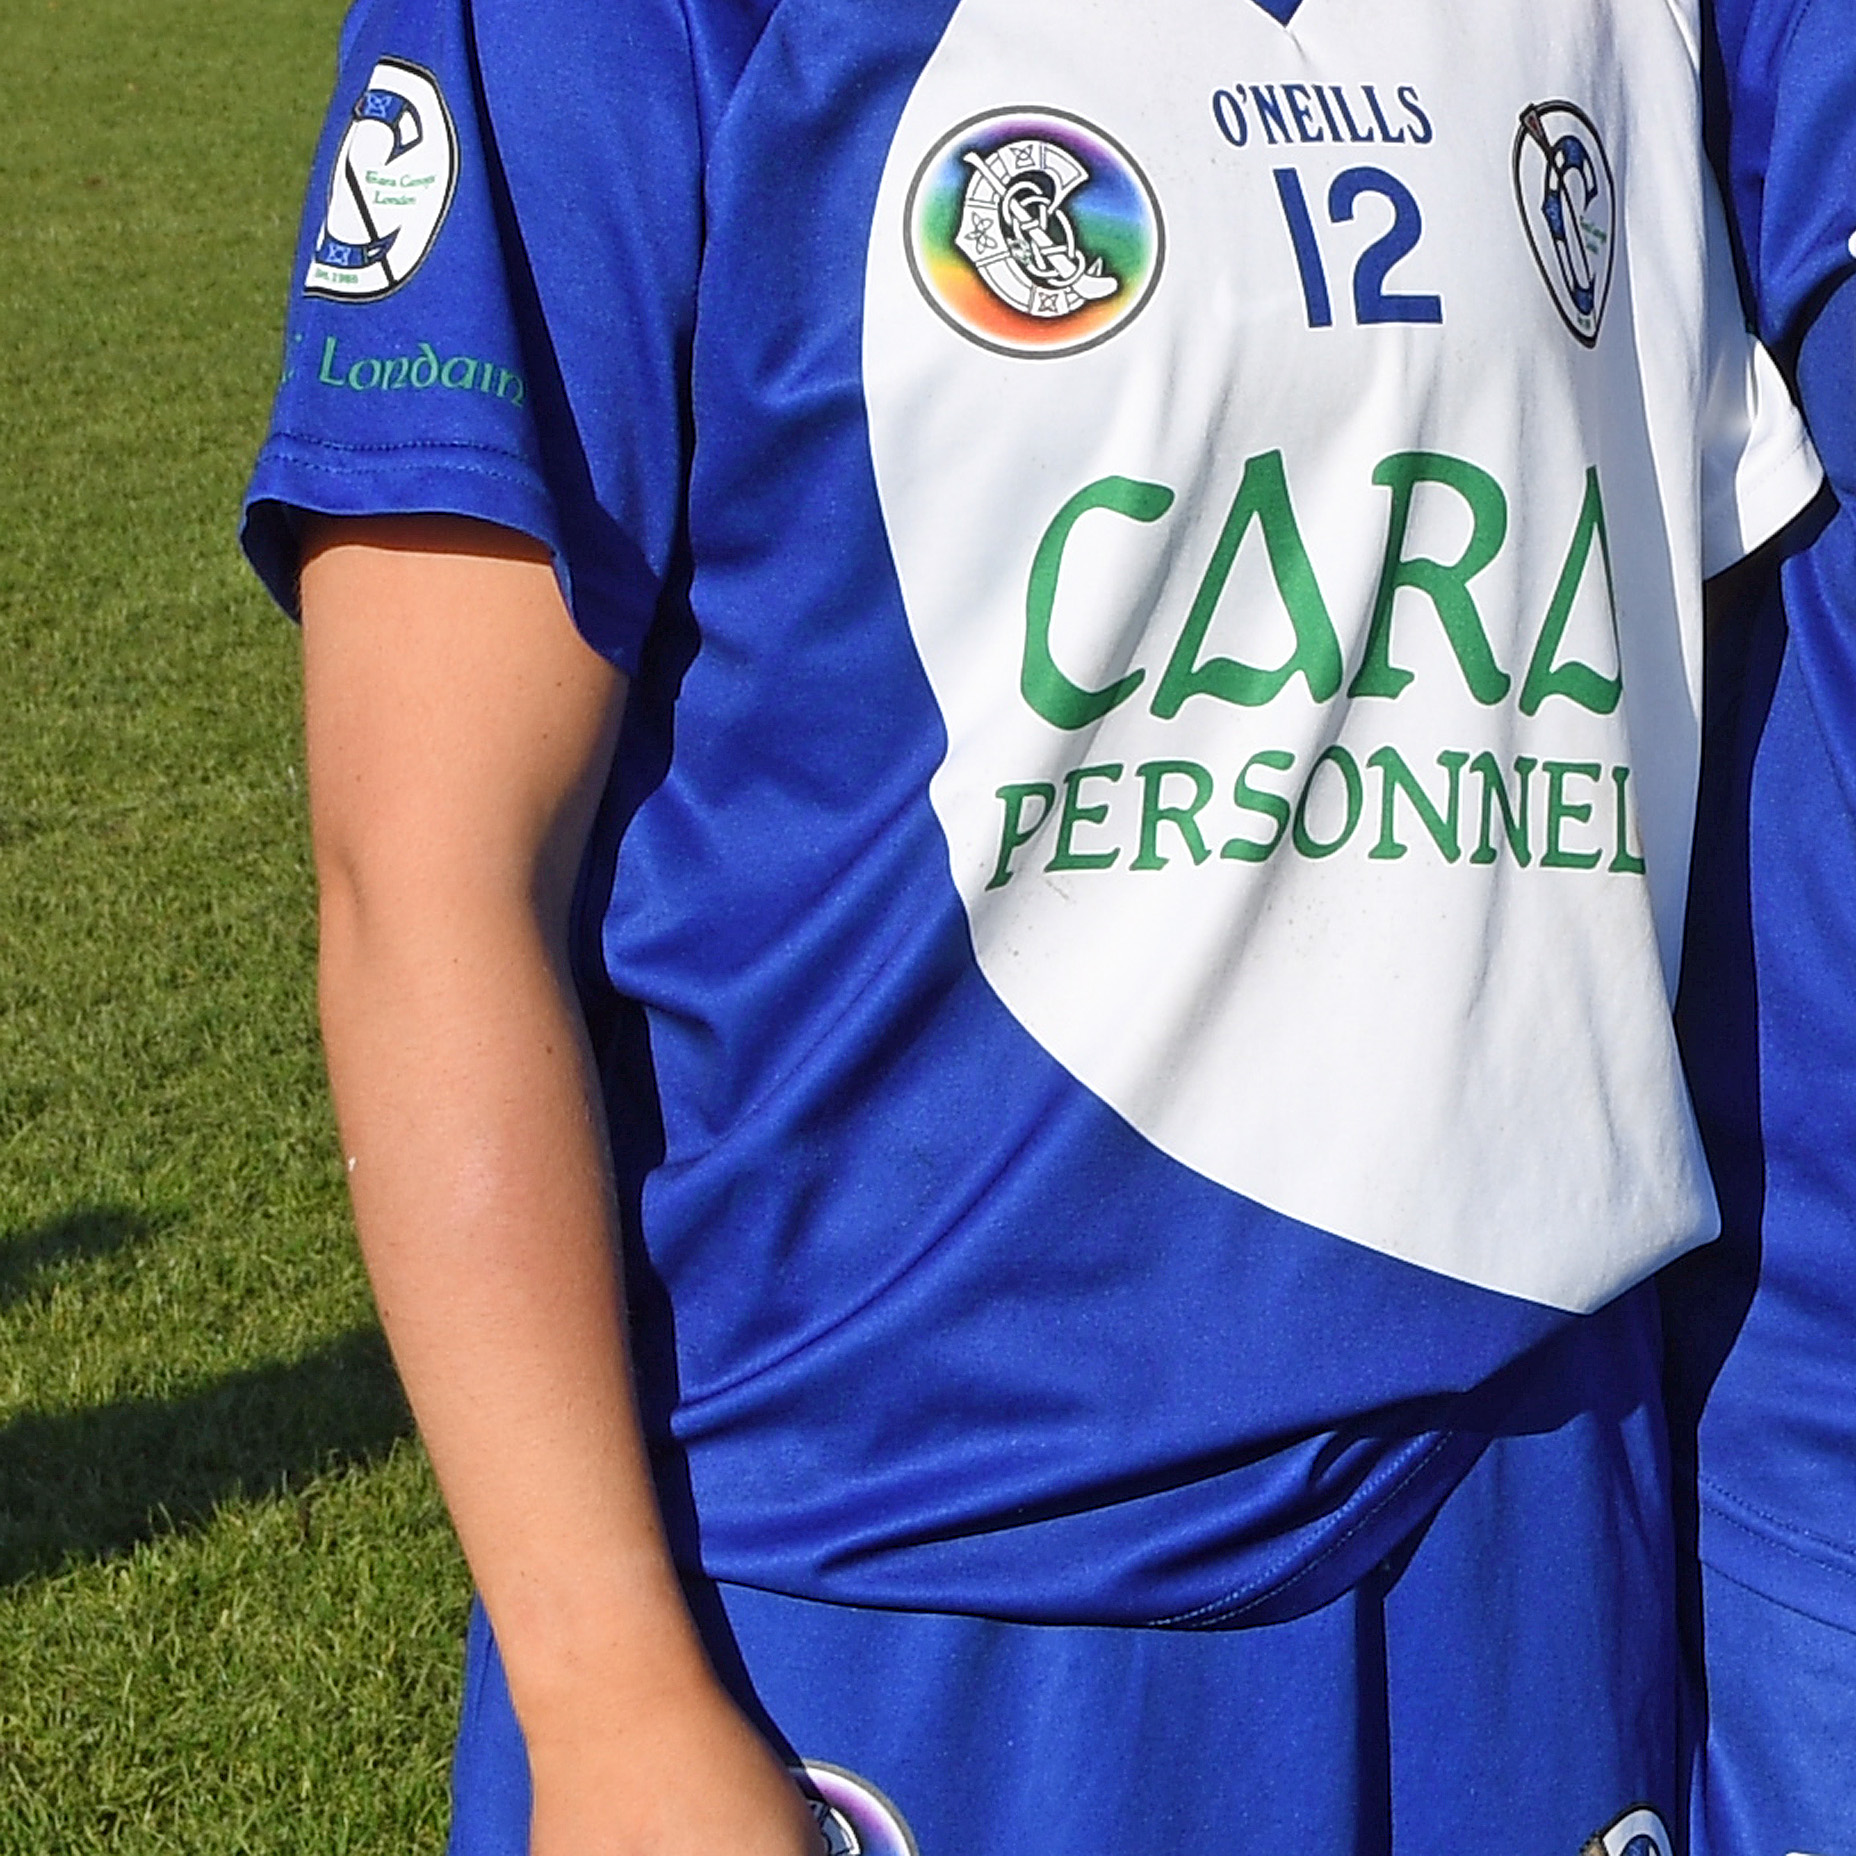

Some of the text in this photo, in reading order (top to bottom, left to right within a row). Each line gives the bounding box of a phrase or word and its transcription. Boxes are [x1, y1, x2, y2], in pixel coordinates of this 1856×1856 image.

[1213, 84, 1433, 147] O'NEILLS
[1274, 166, 1443, 327] 12
[1020, 449, 1625, 731] CARA
[986, 745, 1646, 892] PERSONNEL
